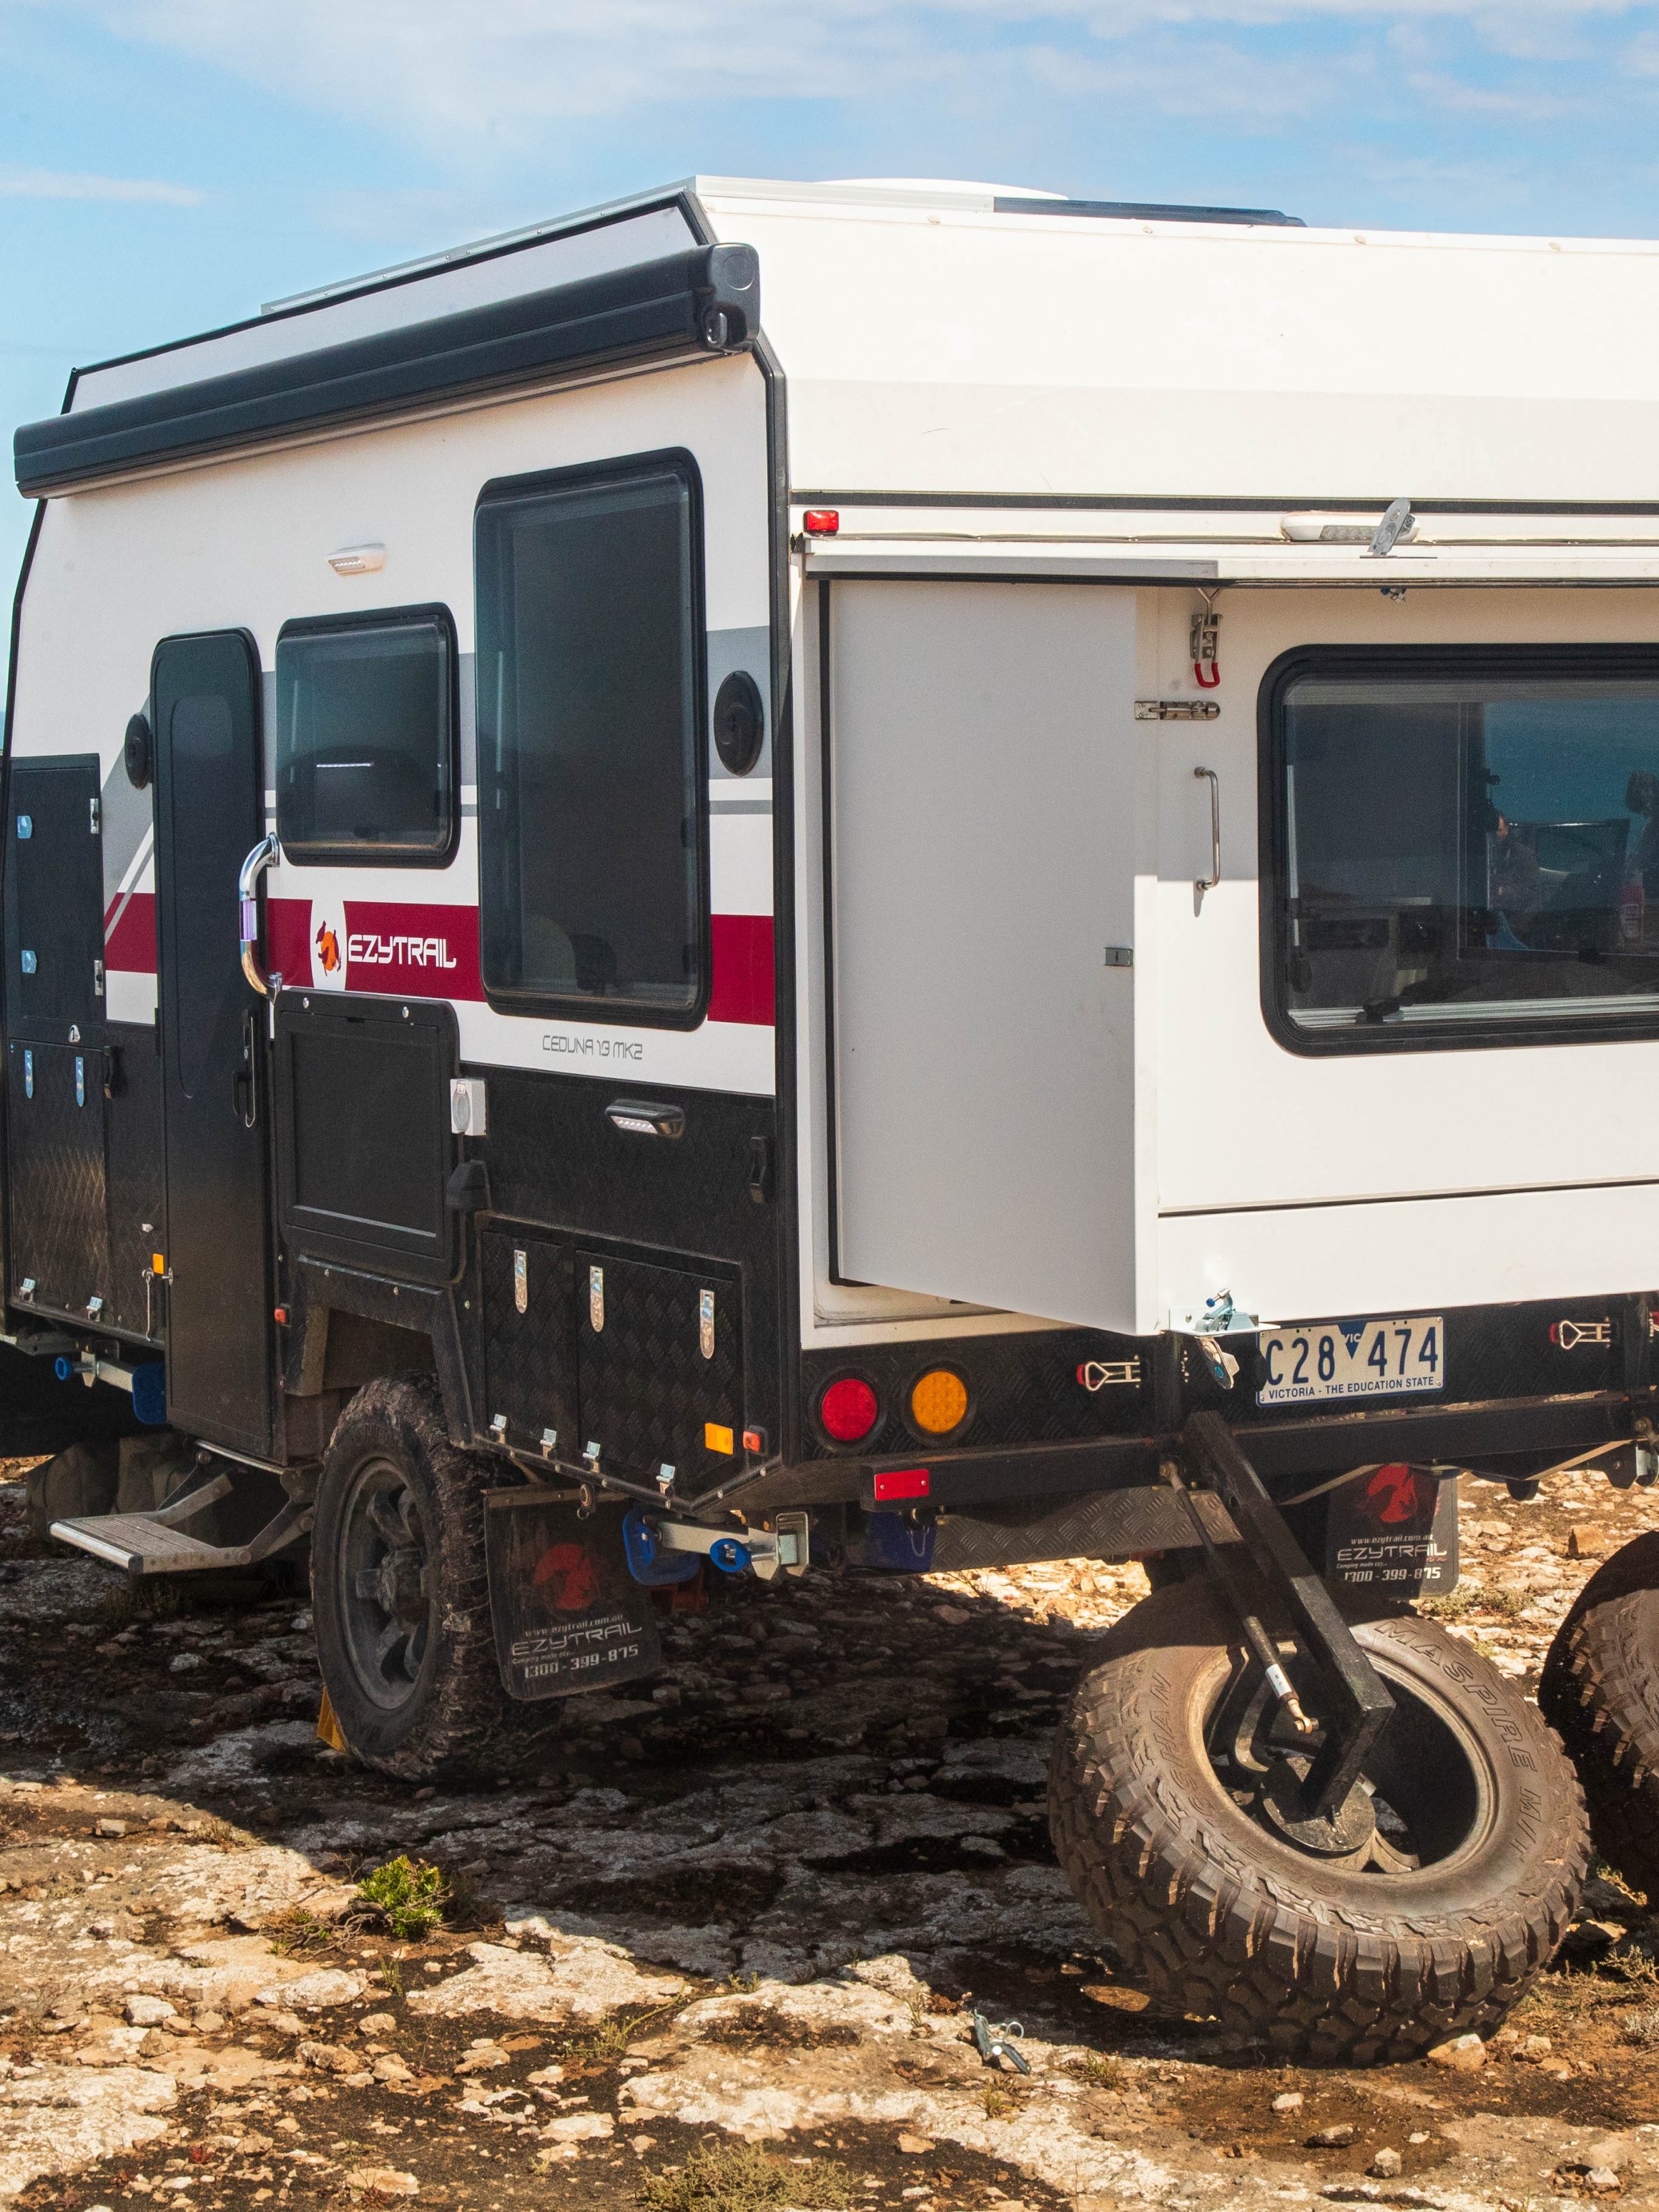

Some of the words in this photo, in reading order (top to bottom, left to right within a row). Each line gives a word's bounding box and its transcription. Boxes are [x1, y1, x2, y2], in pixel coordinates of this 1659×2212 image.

[348, 934, 457, 969] EZYTRAIL
[542, 1035, 594, 1056] CEDUNA
[596, 1040, 610, 1057] 13
[1343, 1333, 1362, 1344] VIC
[1265, 1335, 1335, 1386] C28
[1367, 1326, 1439, 1377] 474
[1269, 1386, 1315, 1399] VICTORIA
[1325, 1383, 1344, 1394] THE
[1347, 1378, 1404, 1393] EDUCATION
[1406, 1376, 1434, 1387] STATE
[1337, 1543, 1447, 1561] EZYTRAIL
[512, 1622, 642, 1655] EZYTRAIL
[1374, 1621, 1539, 1773] MASPIRE
